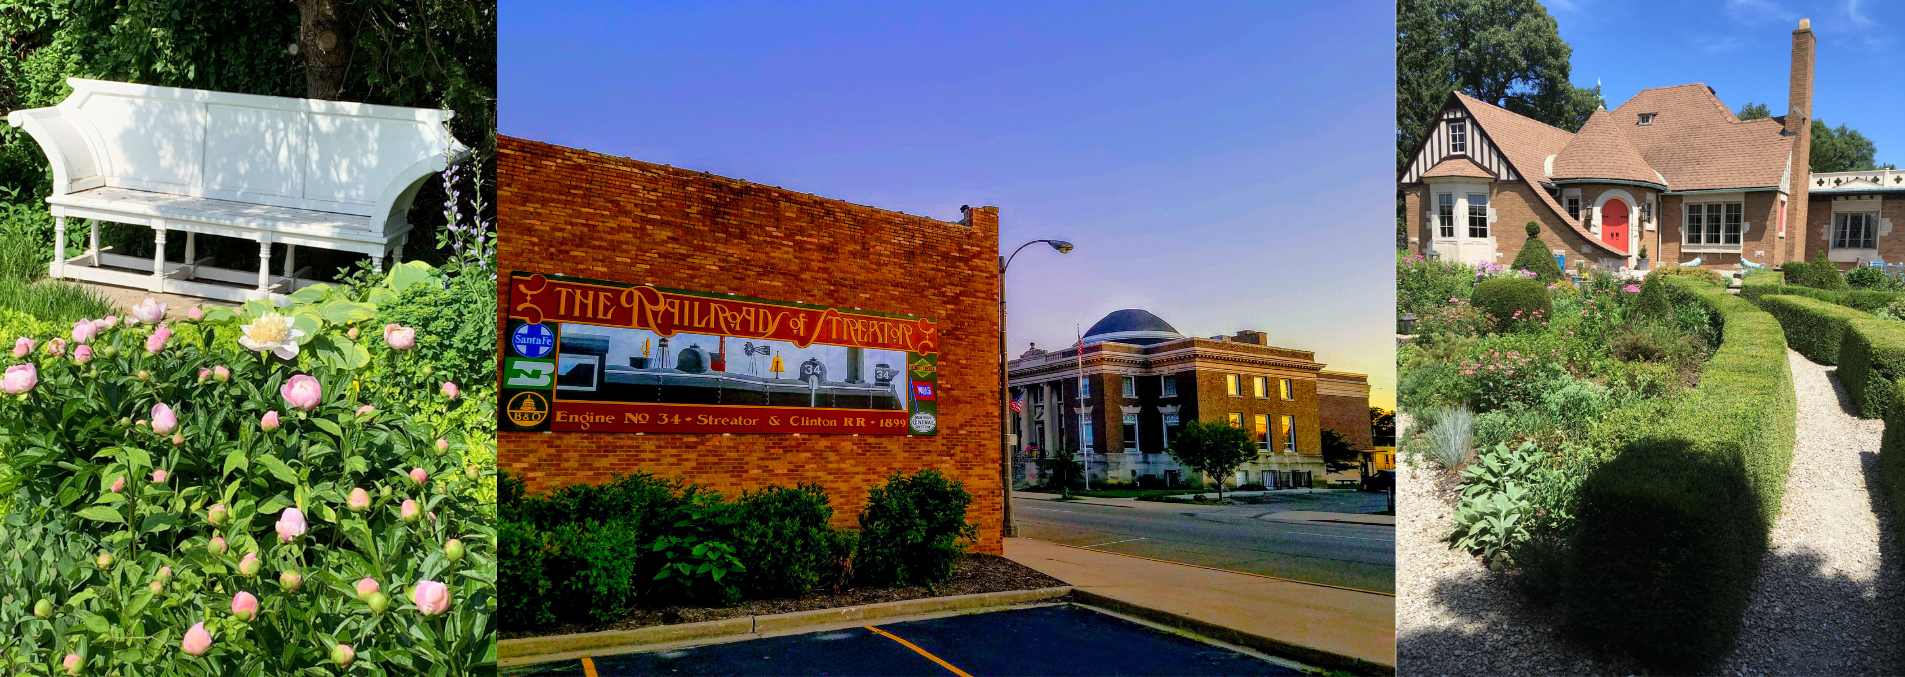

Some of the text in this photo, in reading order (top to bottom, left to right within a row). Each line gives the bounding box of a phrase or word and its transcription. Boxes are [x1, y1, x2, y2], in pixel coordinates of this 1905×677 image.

[552, 285, 915, 352] THE RAILROADS of STREATOR
[515, 334, 541, 345] Santa
[804, 364, 821, 375] 34
[876, 369, 890, 380] 34
[514, 412, 541, 422] B&O
[555, 410, 616, 430] Engine
[657, 413, 681, 425] 34
[696, 414, 760, 426] Streator
[768, 415, 781, 427] &
[789, 415, 838, 427] Clinton
[843, 417, 867, 427] RR
[879, 418, 907, 428] 1899
